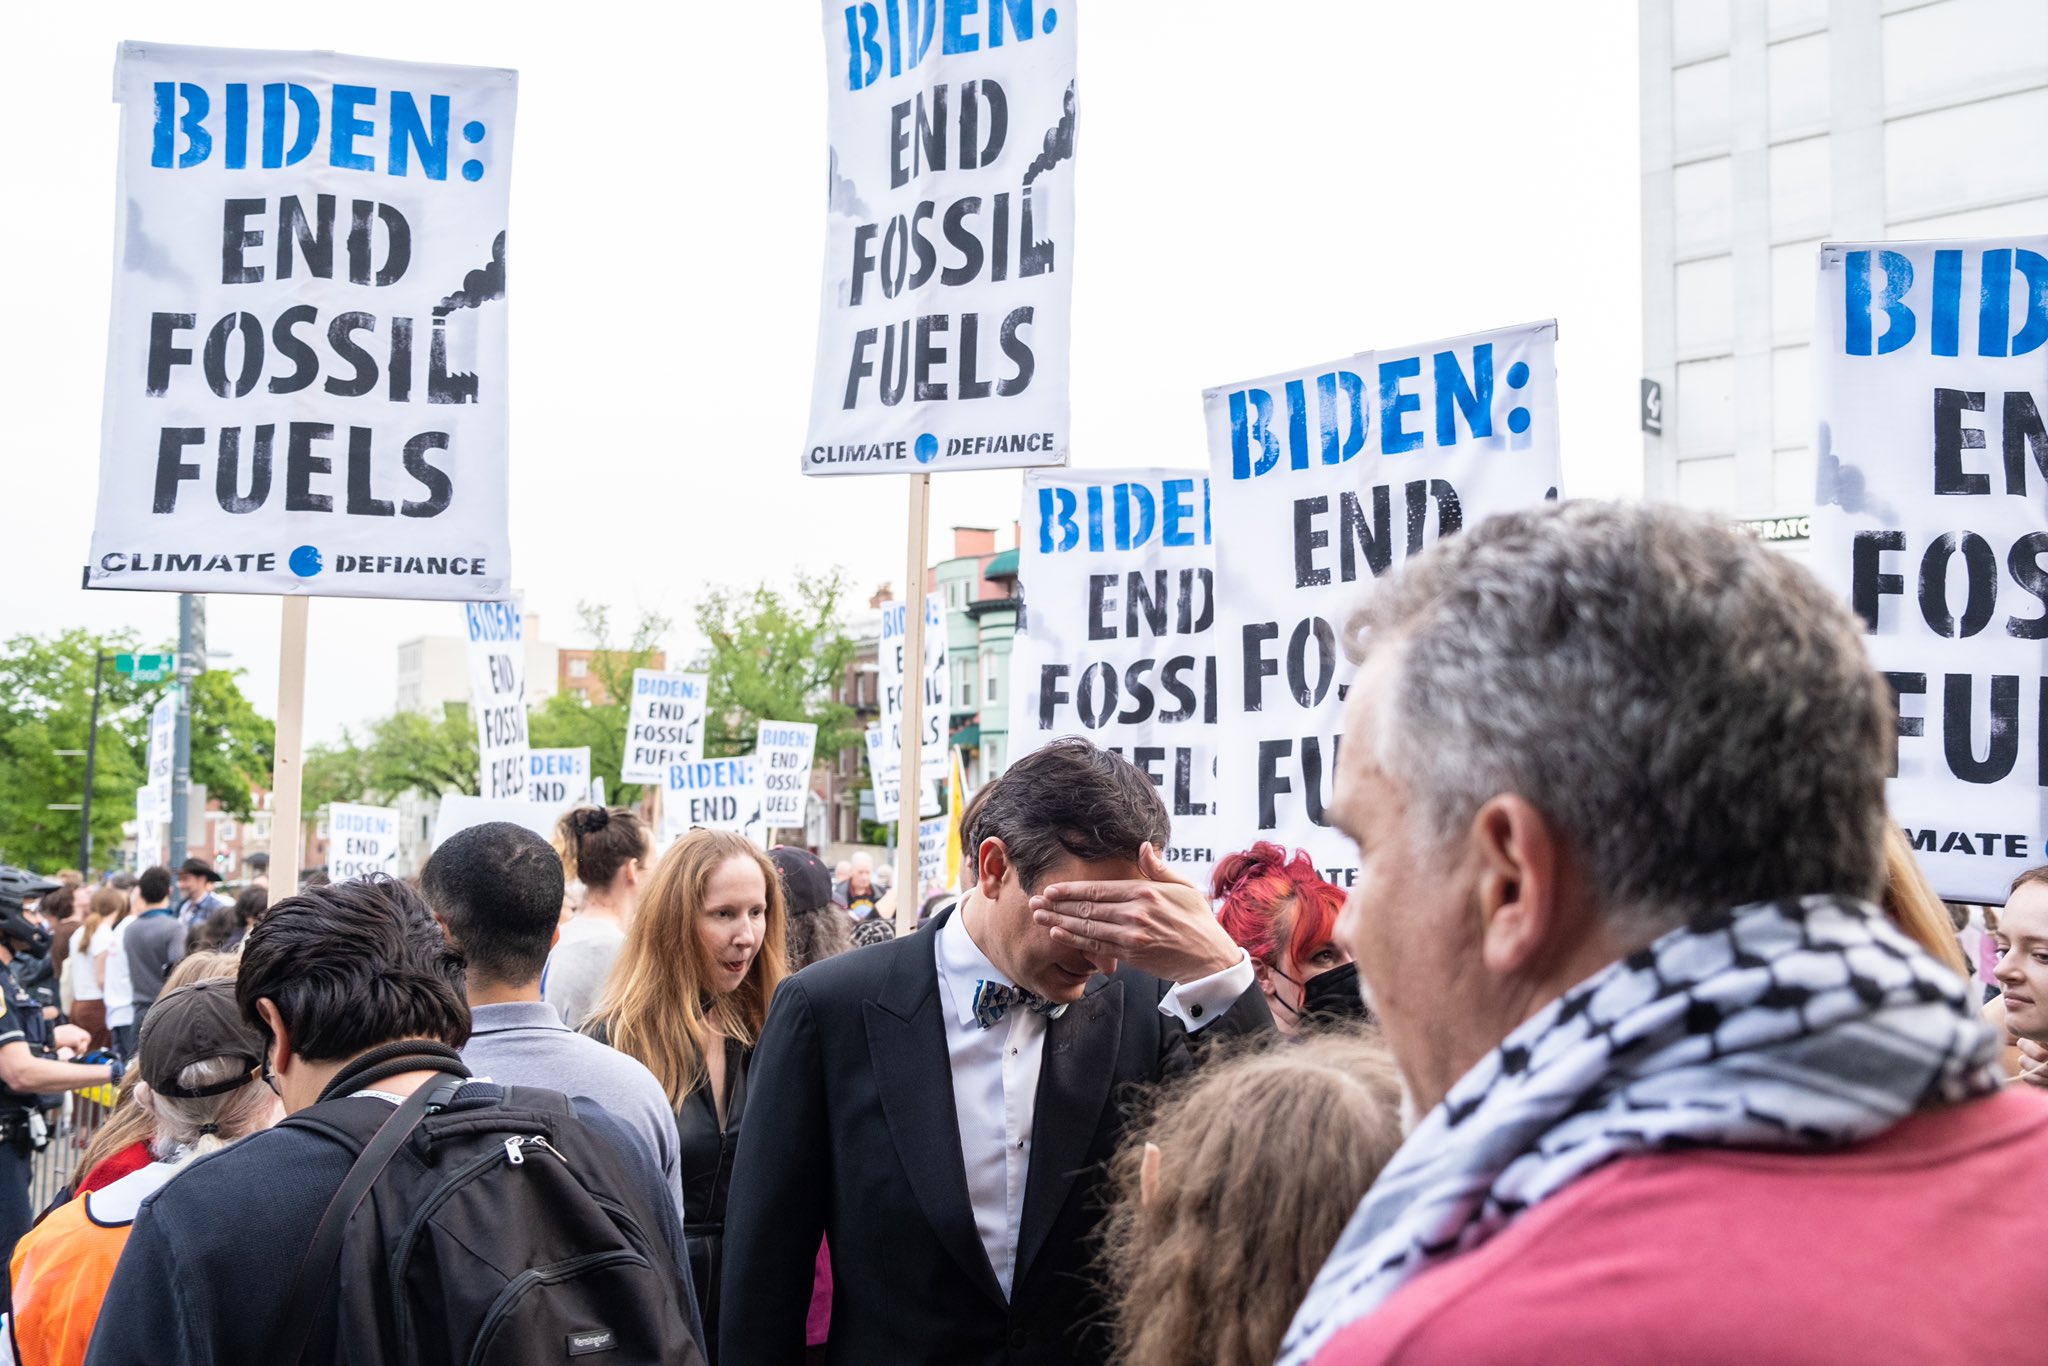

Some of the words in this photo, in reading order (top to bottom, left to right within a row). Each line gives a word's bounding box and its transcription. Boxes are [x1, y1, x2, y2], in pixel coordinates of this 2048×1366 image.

[151, 81, 486, 182] BIDEN:
[890, 79, 1008, 190] END
[221, 194, 412, 287] END
[849, 186, 1055, 307] FOSSIL
[146, 304, 479, 404] FOSSIL
[842, 305, 1035, 410] FUELS
[1228, 343, 1531, 480] BIDEN:
[810, 439, 907, 464] CLIMATE
[946, 432, 1054, 456] DEFIANCE
[152, 421, 453, 518] FUELS
[1294, 479, 1463, 589] END
[101, 551, 276, 574] CLIMATE
[336, 554, 486, 576] DEFIANCE
[1087, 567, 1214, 641] END
[466, 602, 521, 641] BIDEN:
[488, 655, 514, 694] END
[638, 678, 700, 699] BIDEN:
[649, 702, 684, 720] END
[634, 724, 694, 744] FOSSIL
[763, 729, 809, 747] BIDEN:
[530, 755, 581, 776] DEN:
[771, 752, 798, 768] END
[670, 761, 753, 789] BIDEN:
[766, 773, 802, 790] OSSIL
[690, 796, 737, 823] END
[766, 796, 798, 812] UELS
[336, 813, 393, 834] BIDEN:
[347, 838, 378, 855] END
[1167, 847, 1215, 862] DEFI
